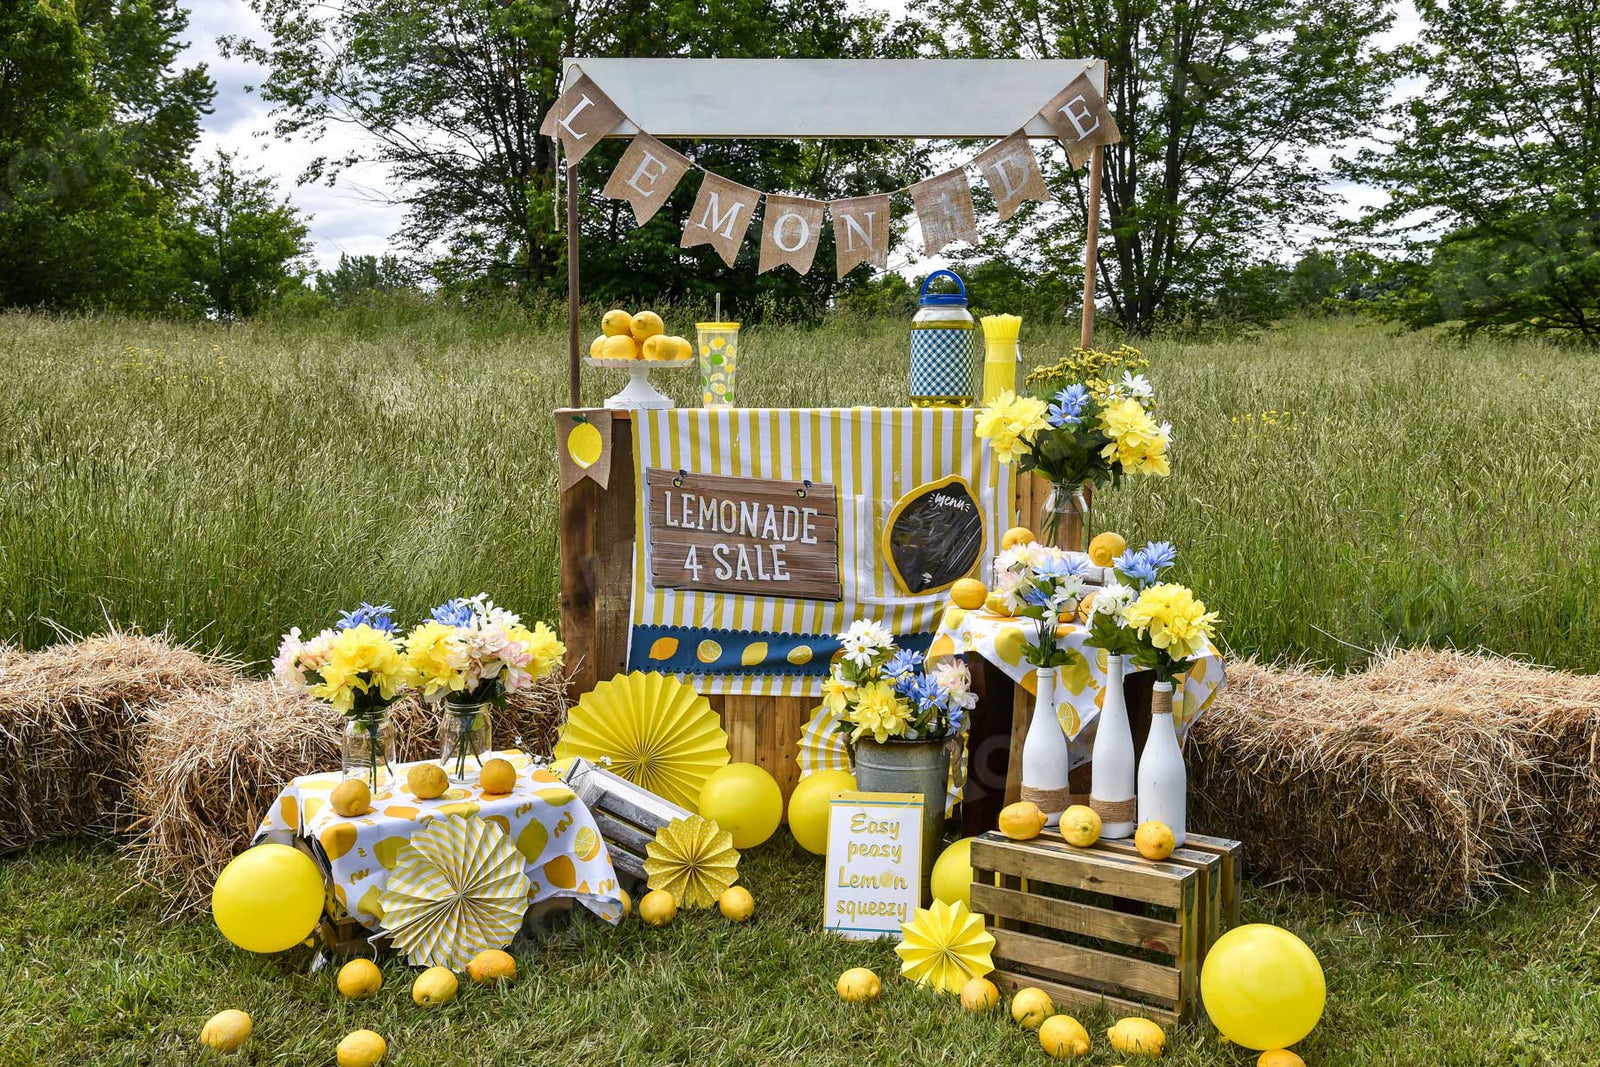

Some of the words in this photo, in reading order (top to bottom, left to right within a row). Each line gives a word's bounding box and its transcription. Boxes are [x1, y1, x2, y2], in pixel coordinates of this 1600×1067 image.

[557, 93, 1100, 254] LEMONADE
[934, 492, 966, 511] menu
[664, 490, 819, 545] LEMONADE
[683, 545, 703, 582] 4
[711, 543, 791, 582] SALE
[850, 812, 900, 840] Easy
[847, 840, 903, 865] peasy
[837, 865, 908, 890] Lemon
[836, 899, 908, 924] squeezy
